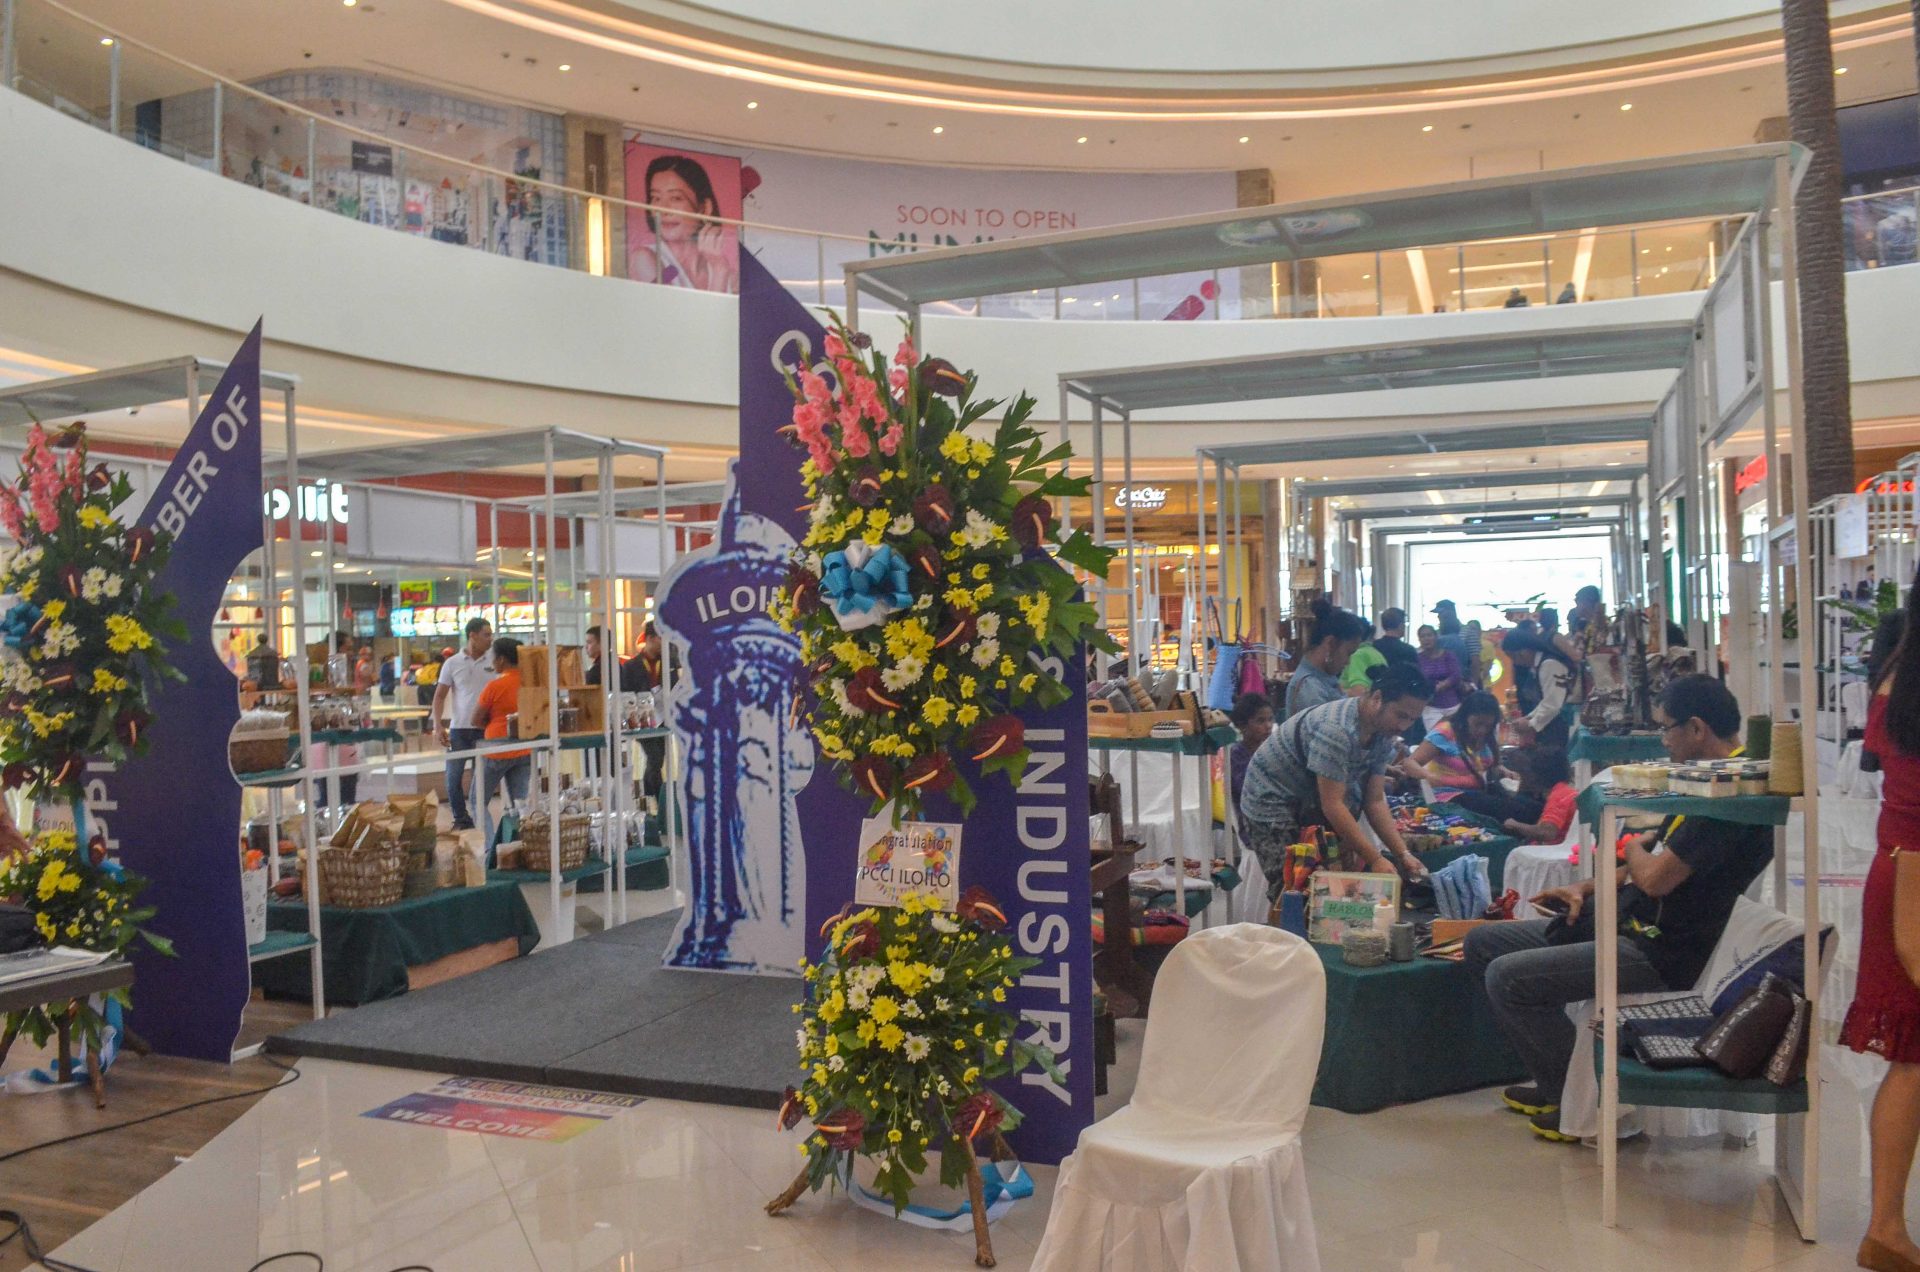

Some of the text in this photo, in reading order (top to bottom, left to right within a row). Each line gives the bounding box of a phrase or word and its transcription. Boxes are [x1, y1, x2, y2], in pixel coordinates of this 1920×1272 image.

[896, 204, 1076, 229] SOON TO OPEN
[151, 384, 249, 542] BER OF
[861, 866, 951, 888] PCCI ILOILO
[1016, 729, 1072, 1107] INDUSTRY
[388, 1108, 553, 1138] WELCOME
